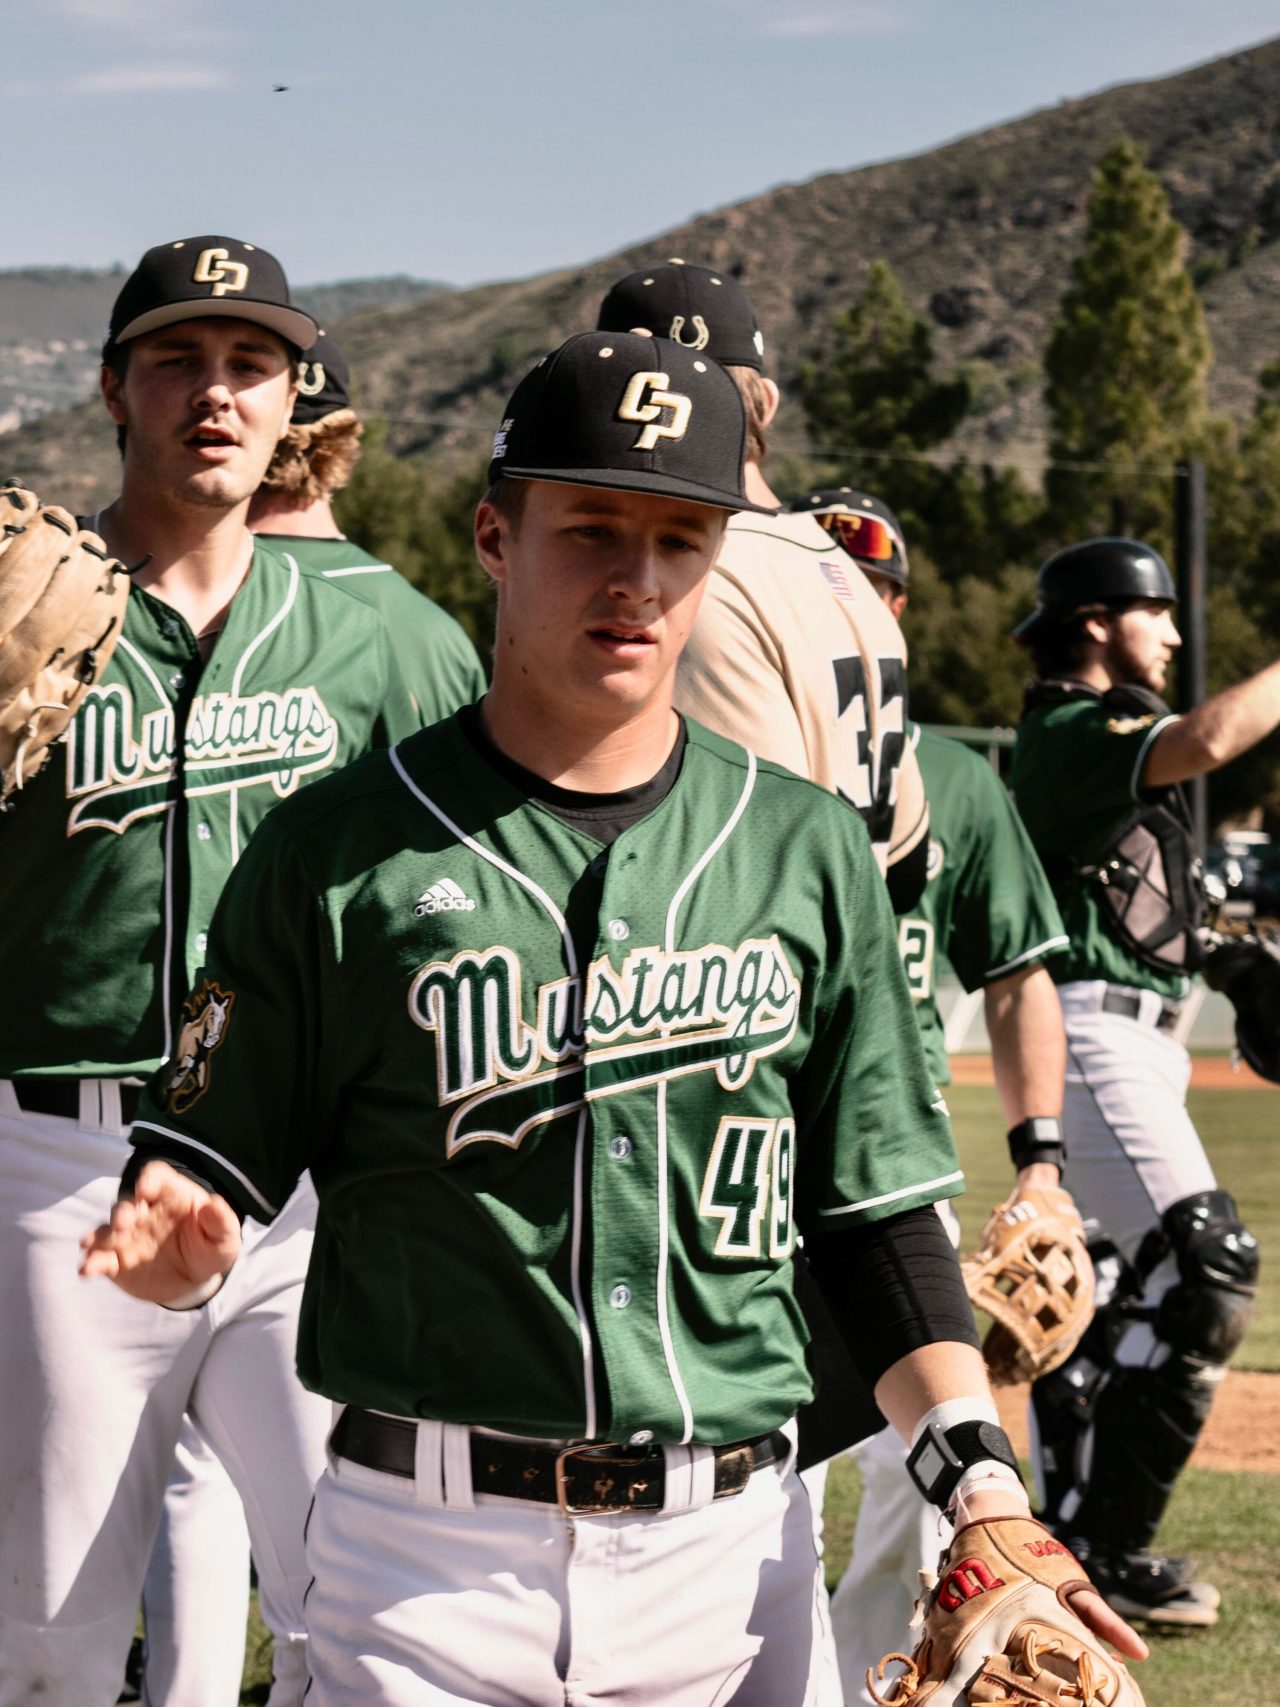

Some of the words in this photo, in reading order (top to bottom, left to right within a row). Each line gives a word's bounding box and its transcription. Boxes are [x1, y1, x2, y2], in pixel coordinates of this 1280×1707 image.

[618, 371, 693, 450] CP
[66, 683, 338, 799] Mustangs
[414, 896, 476, 917] adidas
[408, 933, 801, 1107] Mustangs
[699, 1115, 795, 1259] 49
